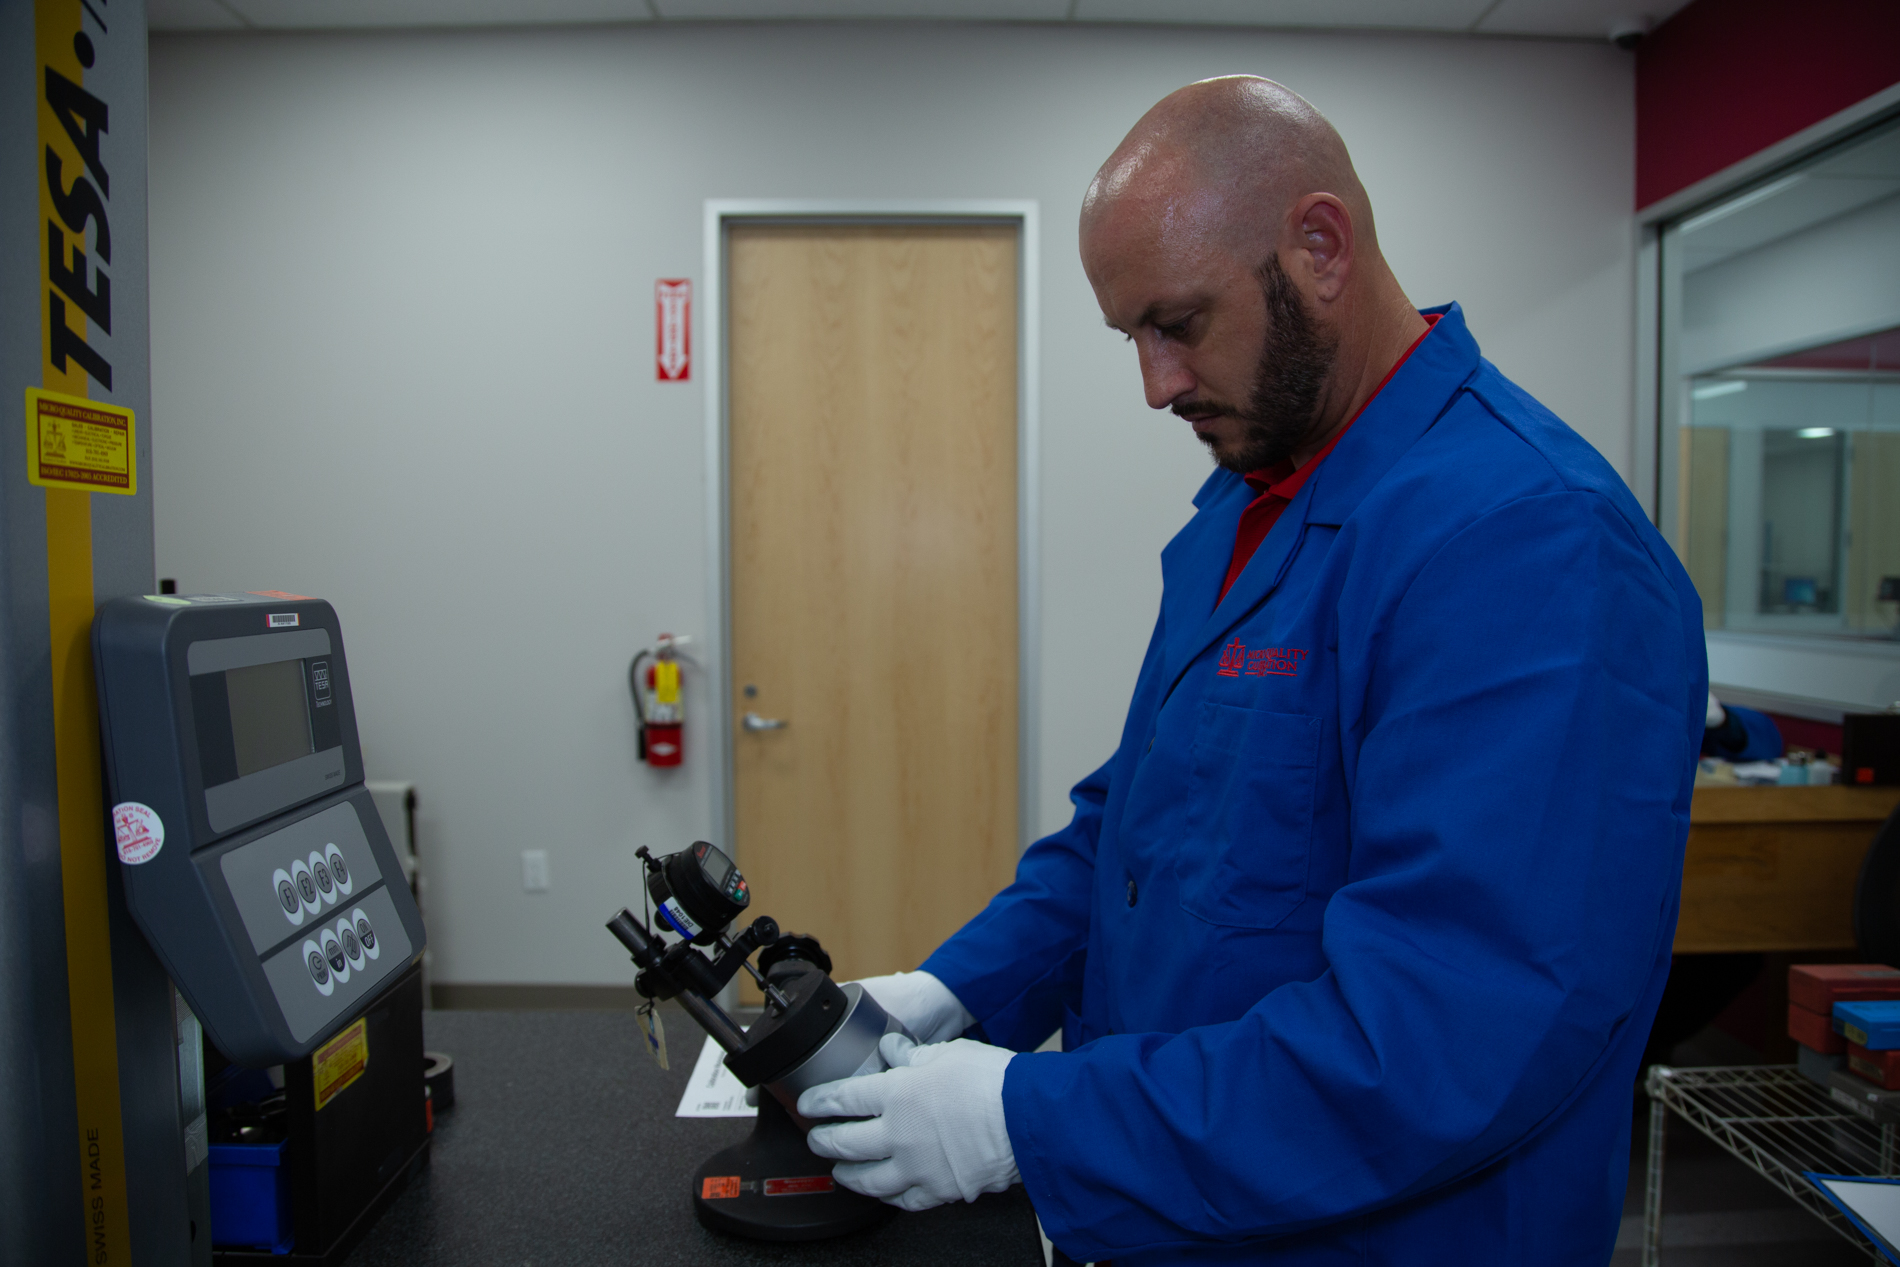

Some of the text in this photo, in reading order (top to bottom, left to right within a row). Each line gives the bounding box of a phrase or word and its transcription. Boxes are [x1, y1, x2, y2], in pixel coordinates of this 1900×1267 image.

[45, 64, 112, 393] TESA
[135, 806, 150, 818] SEAL
[142, 838, 161, 860] REMOVE
[283, 860, 346, 906] F1 F2 F3 F4
[364, 934, 374, 948] OFF
[87, 1128, 107, 1266] SWISS MADE
